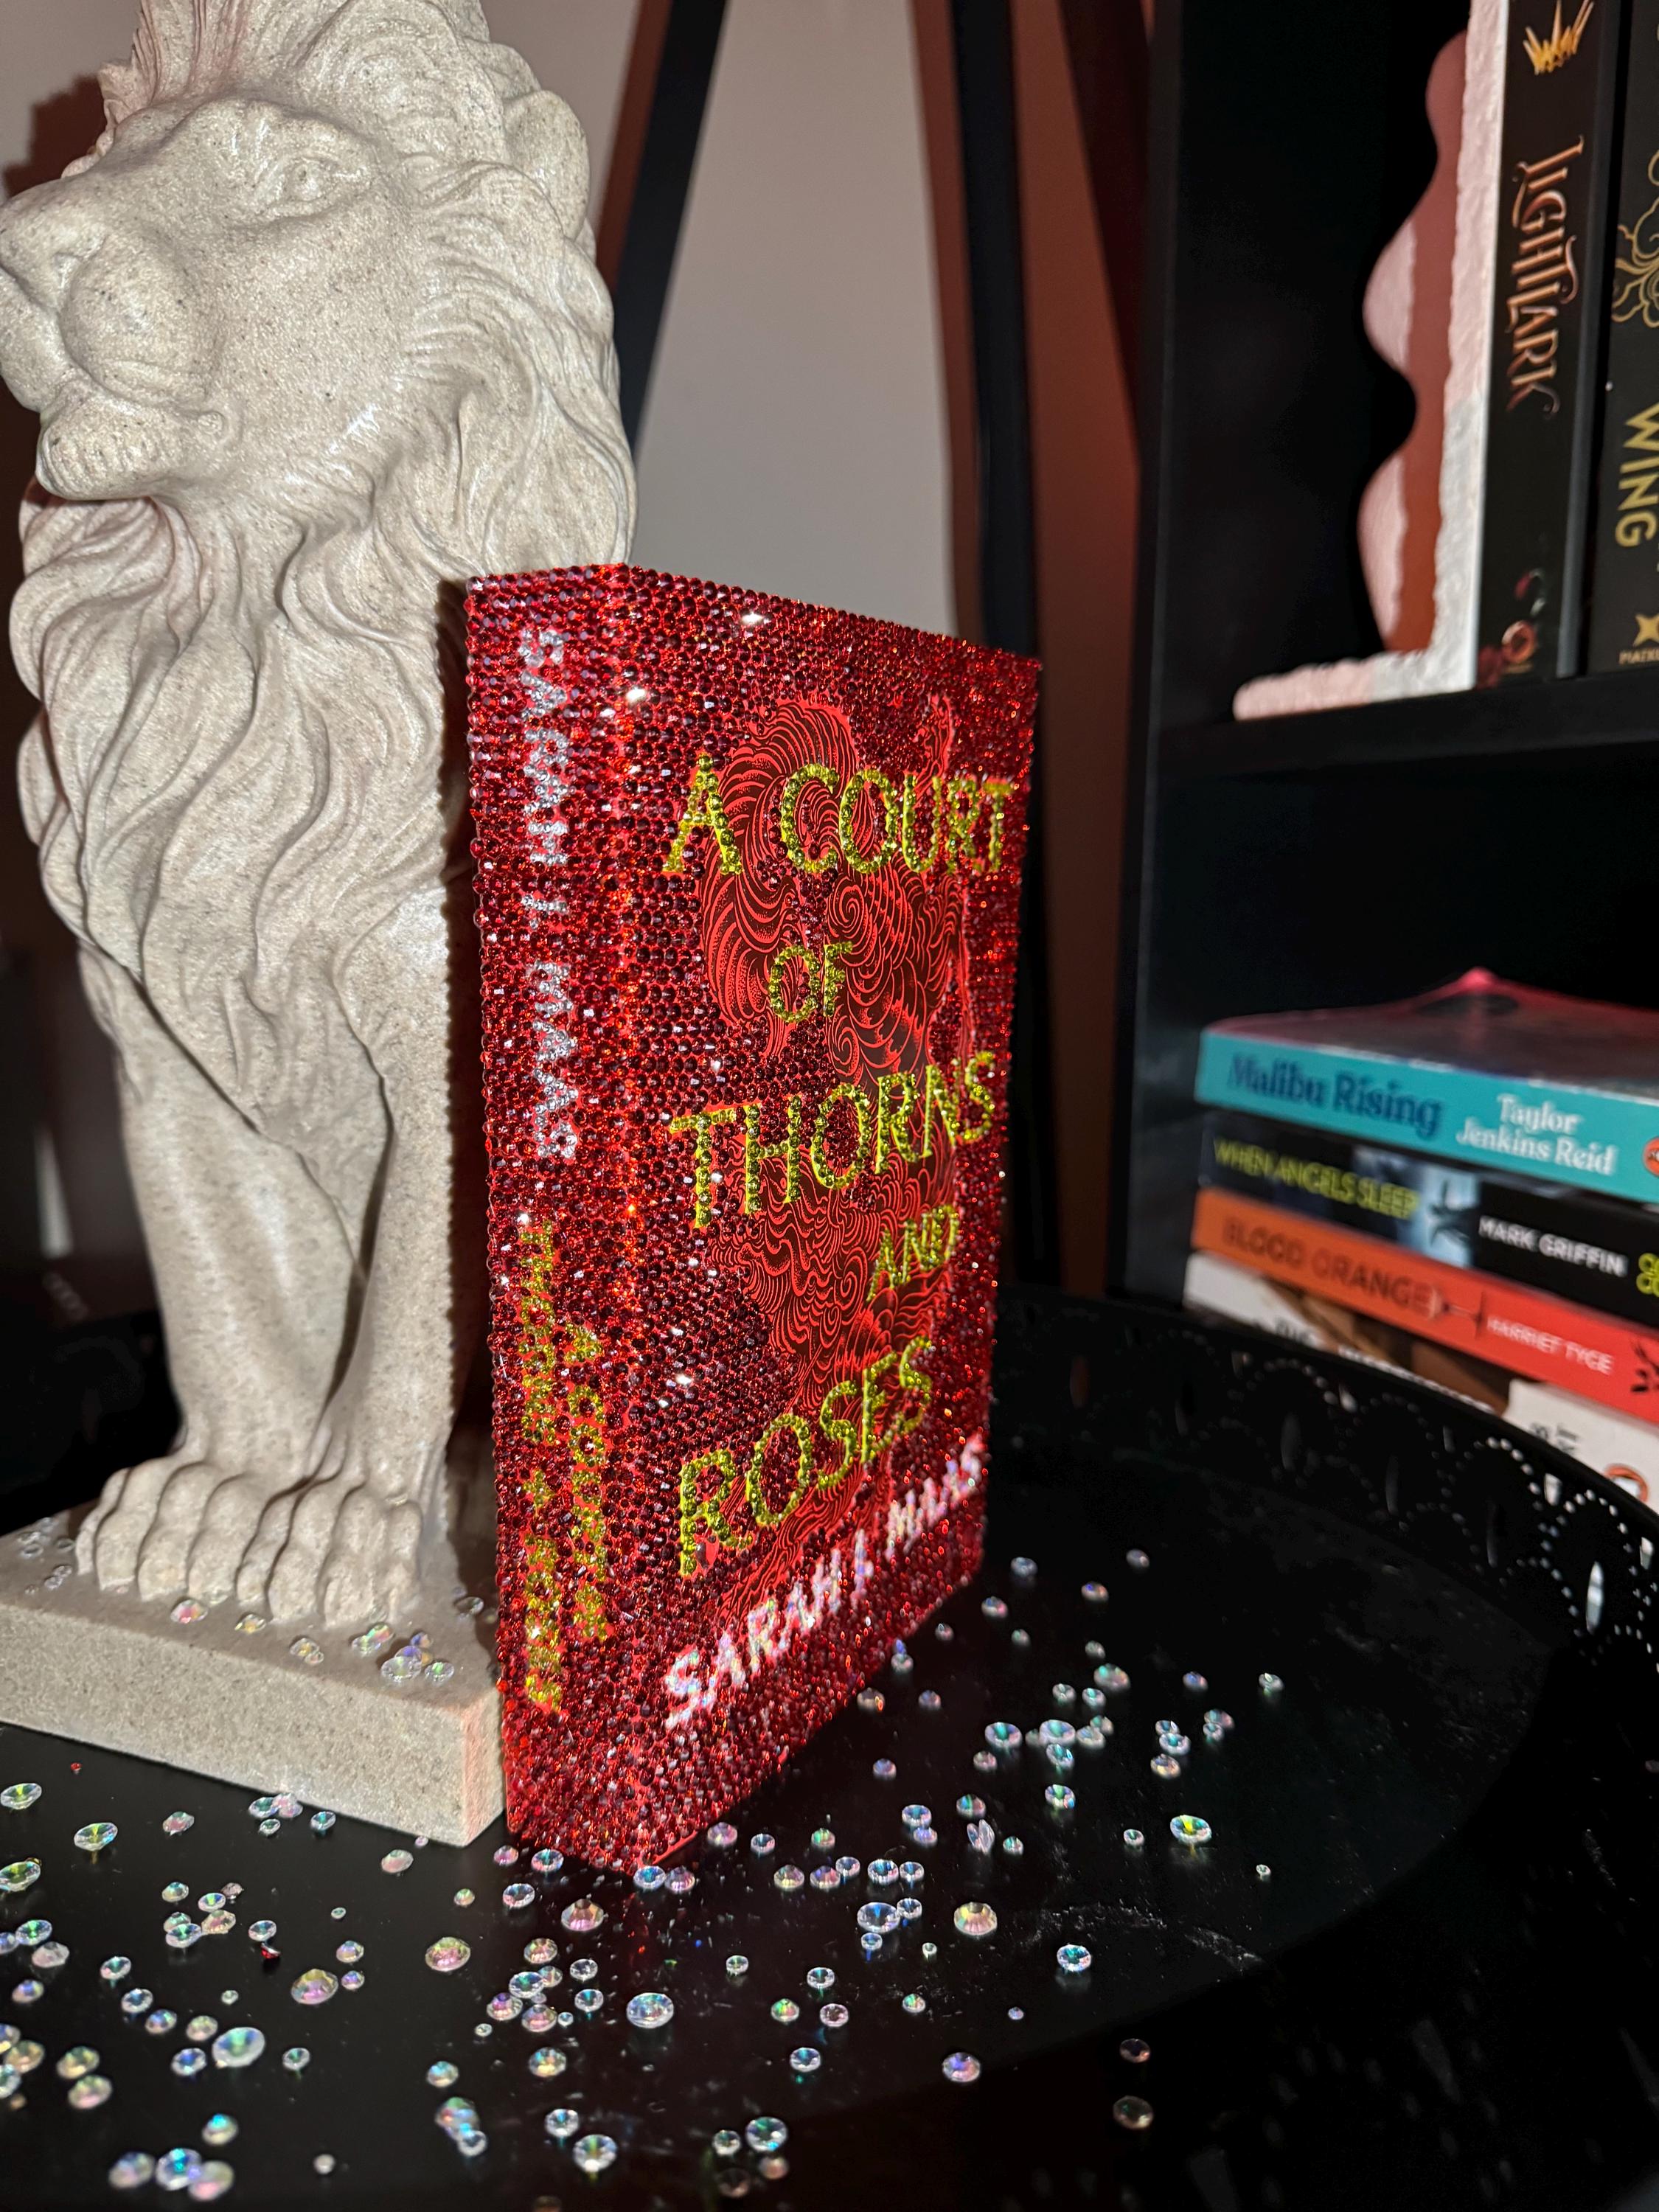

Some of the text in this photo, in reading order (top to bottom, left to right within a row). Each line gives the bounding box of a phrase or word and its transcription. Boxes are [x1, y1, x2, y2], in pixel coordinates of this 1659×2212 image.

[1504, 134, 1585, 418] LIGHTLARK
[1615, 403, 1659, 547] WING
[518, 627, 571, 867] SARAH
[662, 752, 1016, 876] A COURT
[767, 941, 853, 1023] OF
[529, 961, 579, 1159] MAAS
[1228, 1053, 1443, 1141] Malibu Rising
[1498, 1093, 1582, 1134] Taylor
[669, 1051, 997, 1228] THORNS
[1214, 1138, 1420, 1220] WHEN ANGELS SLEEP
[1456, 1116, 1618, 1175] Jenkins Reid
[866, 1204, 959, 1302] AND
[1223, 1217, 1436, 1317] BLOOD ORANGE
[1478, 1216, 1629, 1277] MARK GRIFFIN
[567, 1385, 607, 1583] COURT
[680, 1335, 933, 1576] ROSES
[665, 1547, 842, 1731] SARAH
[885, 1432, 985, 1563] MAAS
